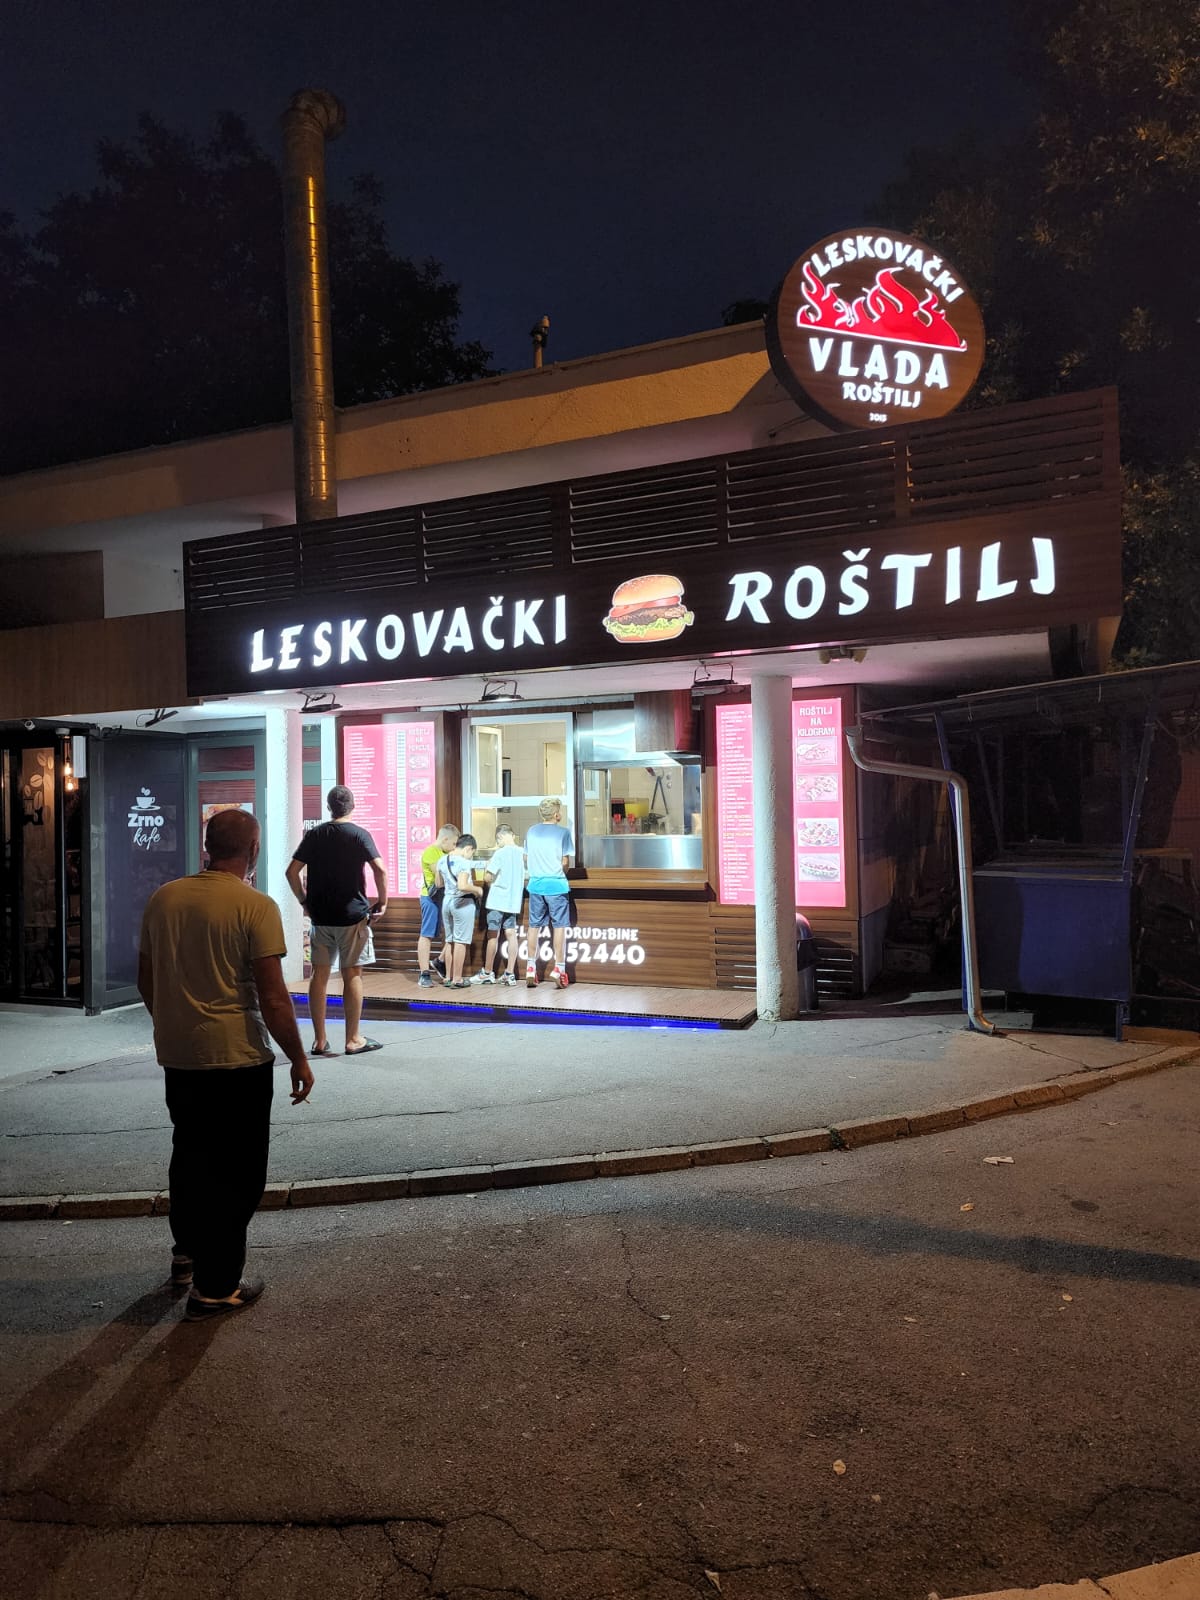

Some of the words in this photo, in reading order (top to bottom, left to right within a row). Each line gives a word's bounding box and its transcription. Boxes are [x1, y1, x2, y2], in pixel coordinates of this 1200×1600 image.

[811, 235, 965, 304] LESKOVAČKI
[809, 338, 949, 389] VLADA
[843, 382, 921, 408] ROŠTILJ
[250, 594, 567, 673] LESKOVAČKI
[725, 537, 1056, 624] ROŠTILJ
[799, 706, 833, 716] ROŠTILJ
[810, 718, 823, 726] NA
[797, 727, 836, 737] KILOGRAM
[127, 813, 164, 827] Zrno
[133, 827, 161, 850] kafe
